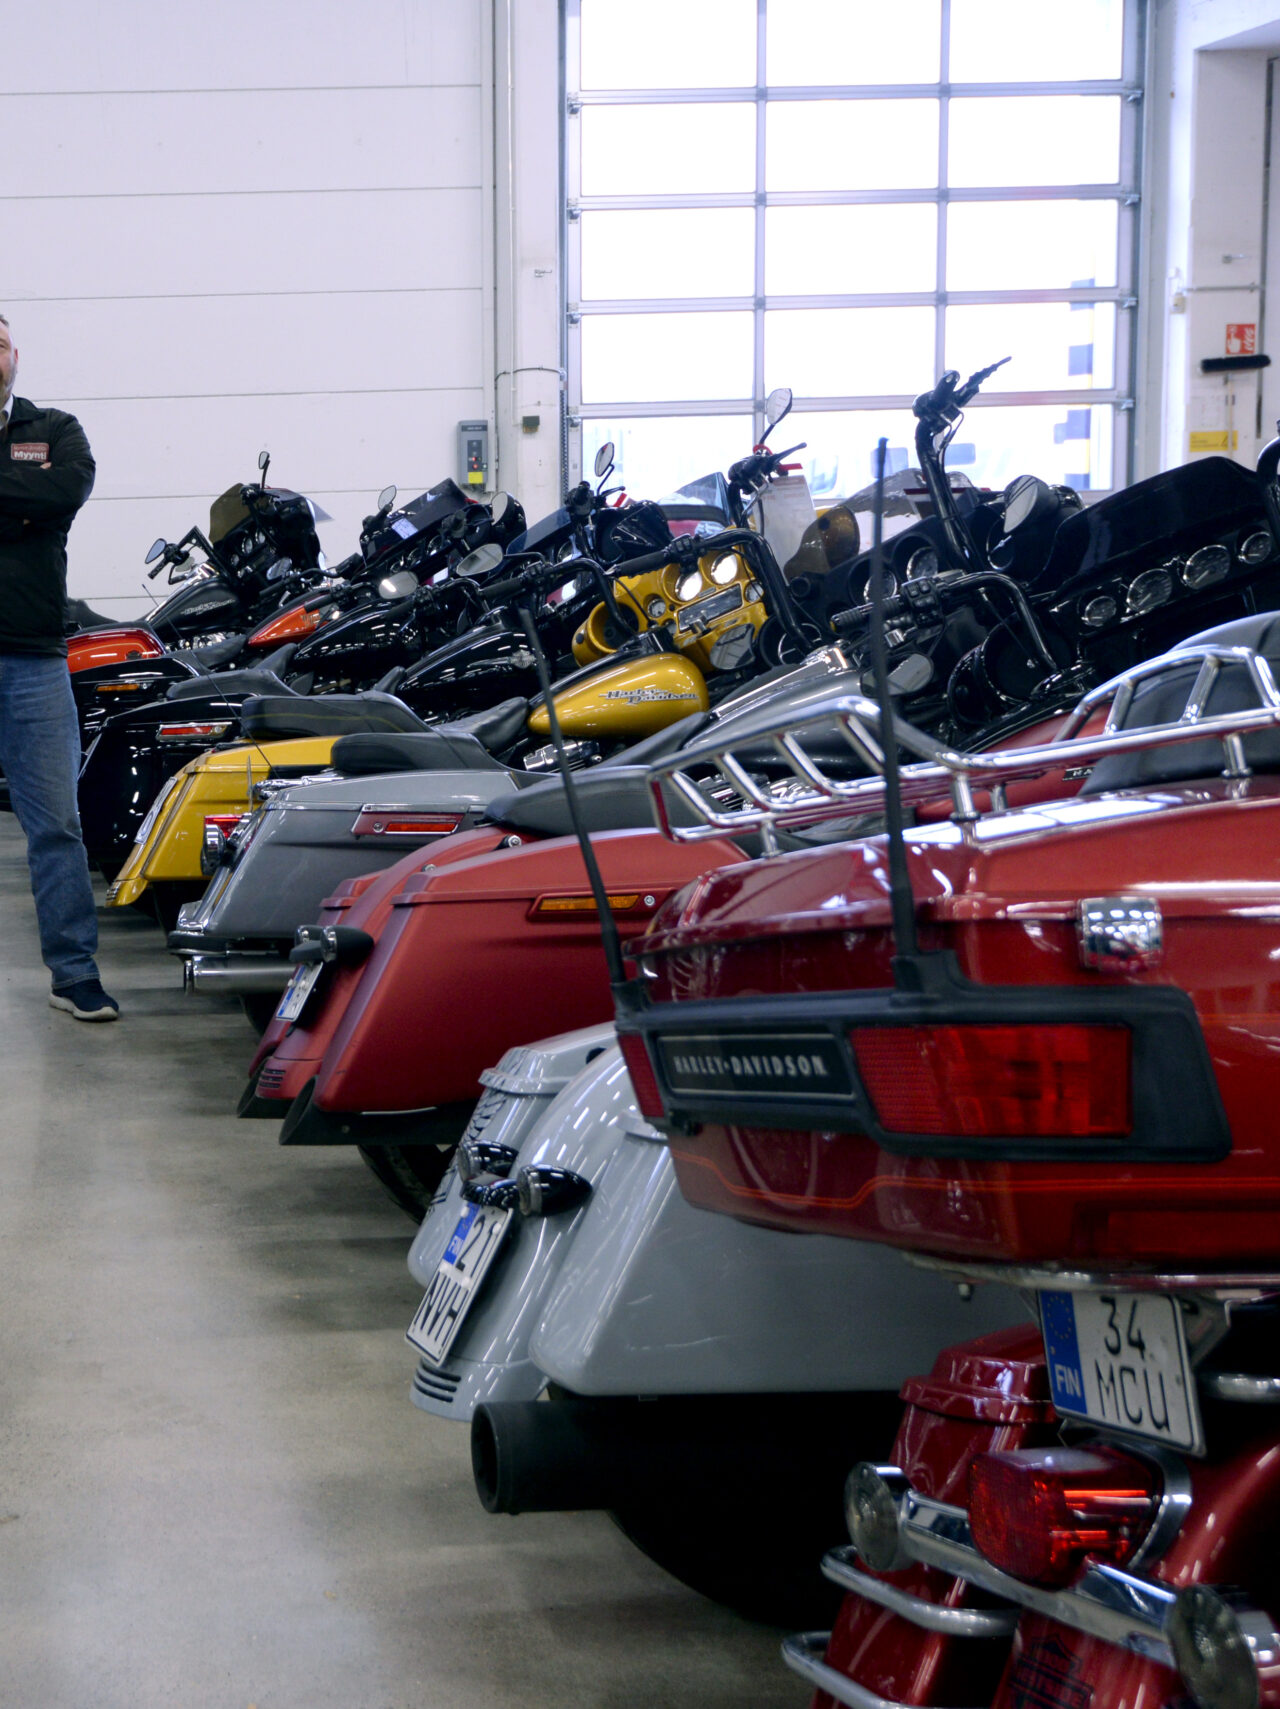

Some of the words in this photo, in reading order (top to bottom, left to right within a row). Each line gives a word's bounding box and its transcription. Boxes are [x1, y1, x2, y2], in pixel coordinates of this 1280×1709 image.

[1100, 1295, 1147, 1361] 34
[1054, 1364, 1082, 1398] FIN
[1095, 1358, 1172, 1433] MCU
